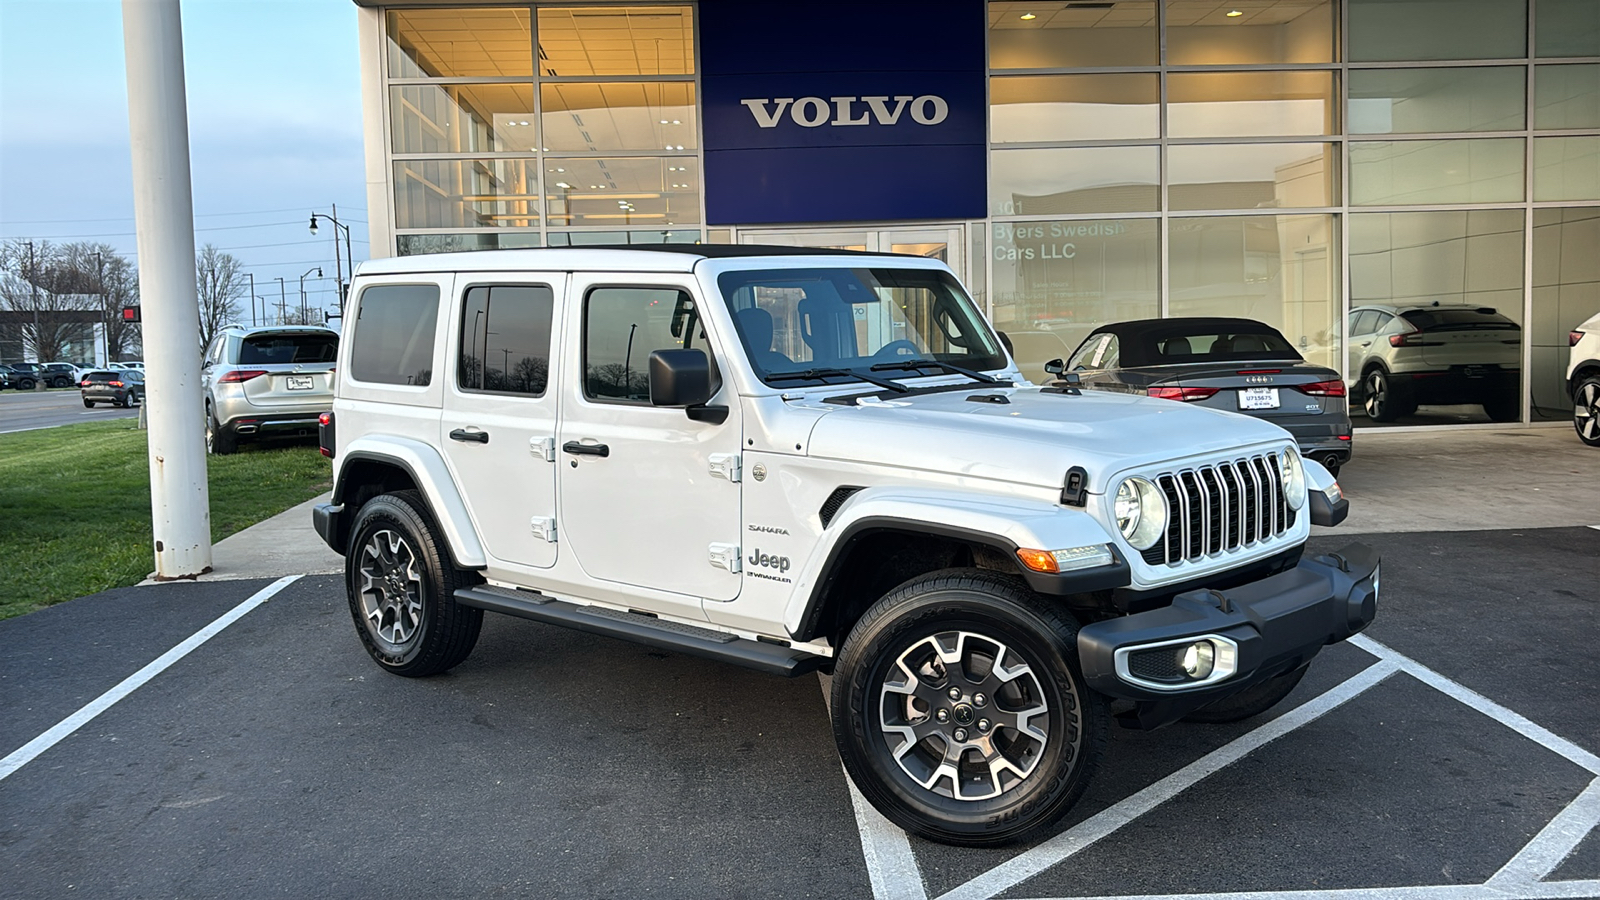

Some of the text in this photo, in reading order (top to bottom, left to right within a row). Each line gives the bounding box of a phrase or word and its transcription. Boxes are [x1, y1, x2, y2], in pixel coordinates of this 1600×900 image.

[741, 95, 949, 128] VOLVO
[994, 223, 1125, 242] Byers Swedish
[994, 243, 1076, 260] Cars LLC
[748, 524, 790, 536] SAHARA
[748, 548, 791, 573] Jeep
[754, 572, 791, 583] WRANGLER
